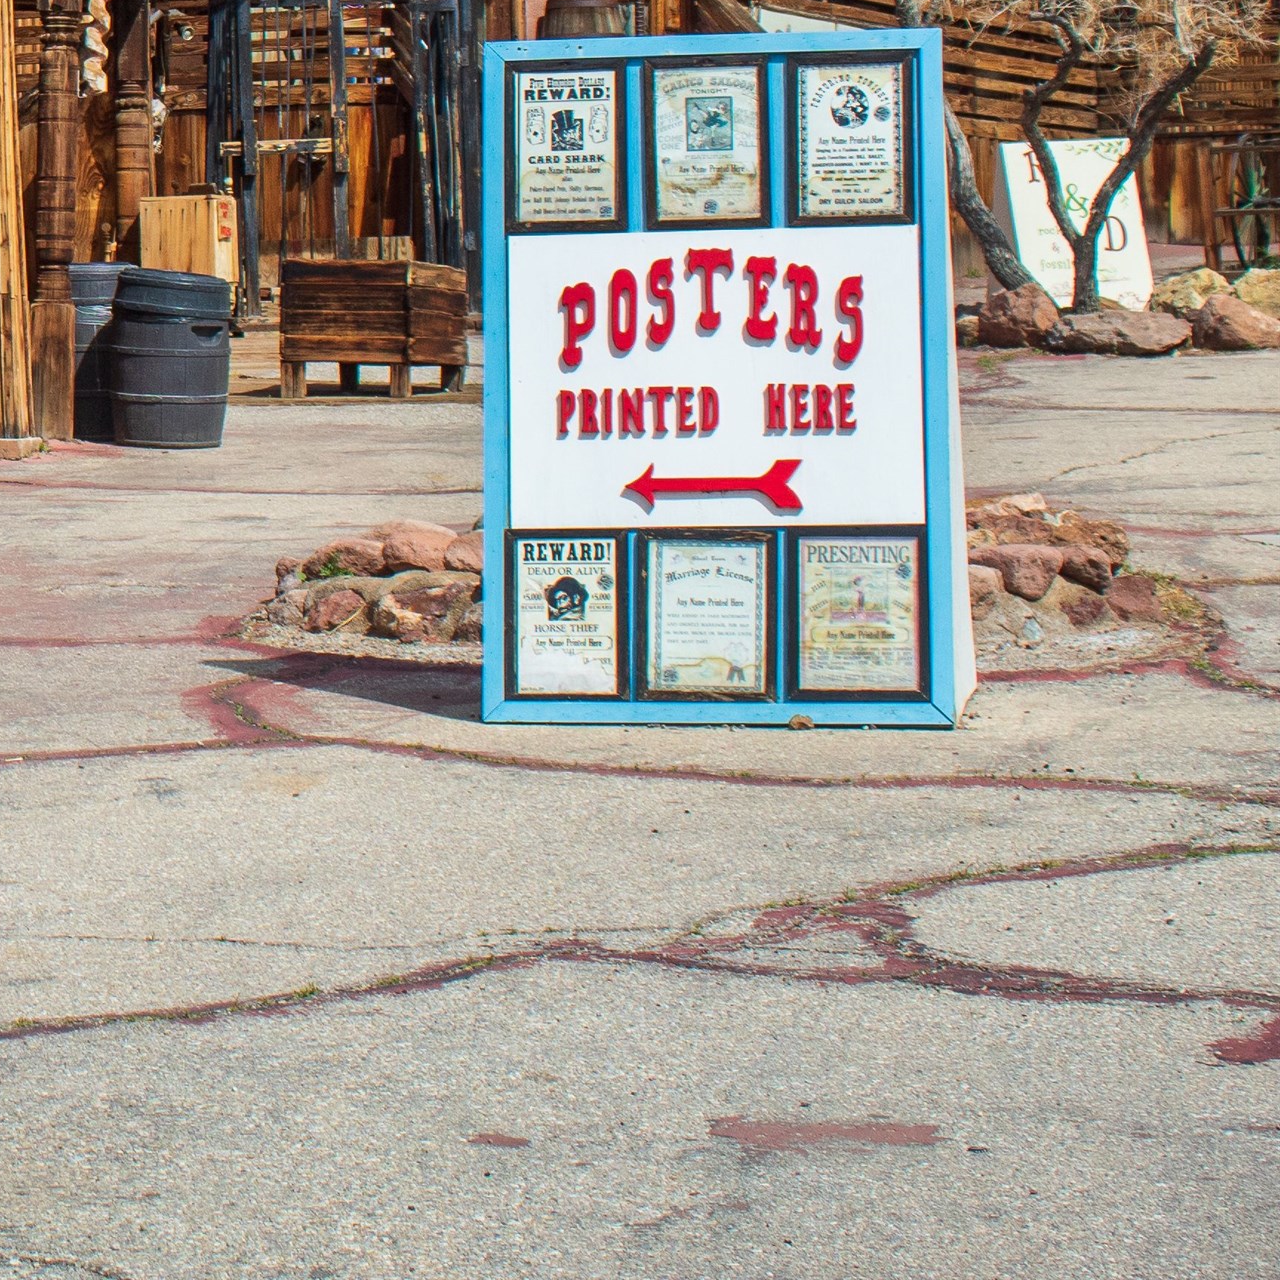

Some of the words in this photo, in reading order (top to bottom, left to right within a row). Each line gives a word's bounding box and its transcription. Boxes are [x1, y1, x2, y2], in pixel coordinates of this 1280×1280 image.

[530, 78, 544, 88] FIVE
[547, 77, 576, 88] HUNDRED
[578, 76, 605, 87] DOLLARS
[662, 77, 704, 94] CALICO
[710, 76, 756, 92] SALOON
[524, 86, 611, 101] REWARD!
[810, 74, 851, 108] FEATURING
[818, 136, 829, 145] Any
[831, 136, 848, 144] Name
[849, 135, 870, 144] Printed
[872, 135, 886, 144] Here
[528, 155, 561, 165] CARD
[565, 153, 606, 164] SHARK
[587, 165, 601, 174] Here
[1064, 183, 1090, 219] &
[1104, 215, 1128, 252] D
[560, 247, 864, 367] POSTERS
[559, 386, 720, 434] PRINTED
[766, 383, 857, 430] HERE
[523, 542, 611, 562] REWARD!
[806, 544, 910, 564] PRESENTING
[527, 567, 556, 576] DEAD
[557, 567, 573, 576] OR
[576, 566, 606, 576] ALIVE
[665, 567, 710, 583] Marriage
[715, 565, 754, 584] License
[676, 597, 688, 607] Any
[690, 597, 706, 606] Name
[708, 596, 729, 607] Printed
[730, 597, 745, 607] Here
[534, 624, 568, 633] HORSE
[570, 623, 599, 632] THIEF
[840, 631, 857, 640] Name
[858, 630, 880, 640] Printed
[881, 630, 895, 640] Here
[536, 638, 547, 647] Any
[548, 638, 565, 647] Name
[566, 638, 587, 647] Printed
[588, 638, 602, 647] Here
